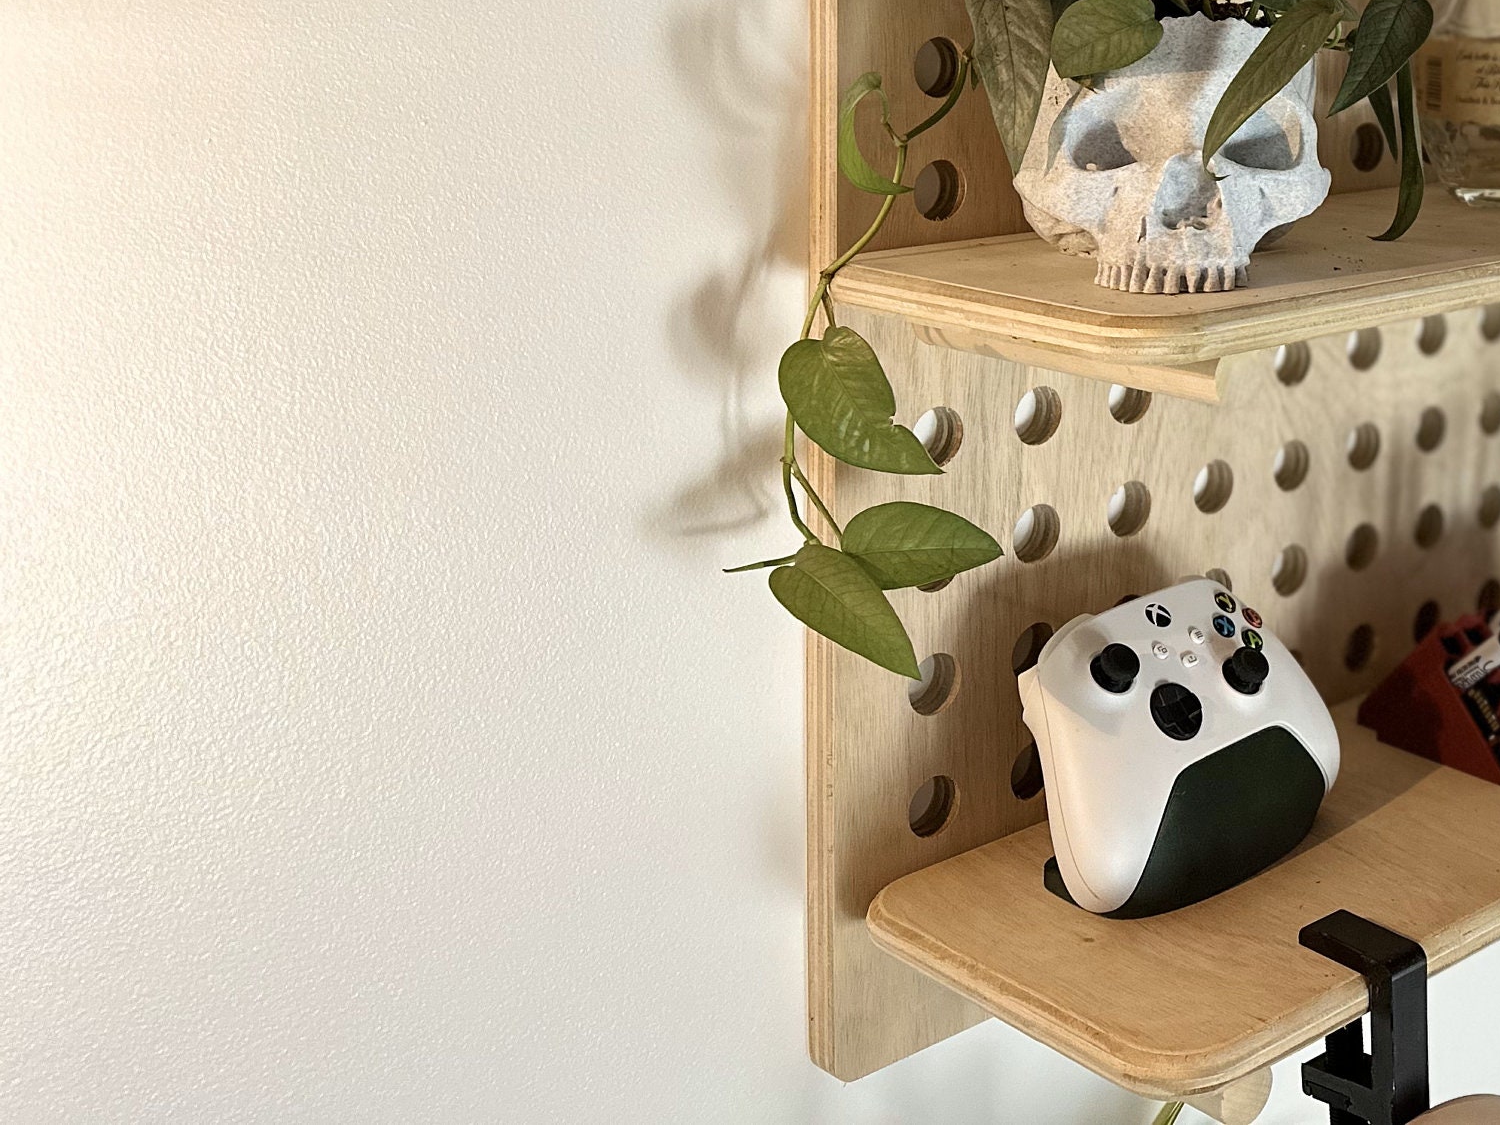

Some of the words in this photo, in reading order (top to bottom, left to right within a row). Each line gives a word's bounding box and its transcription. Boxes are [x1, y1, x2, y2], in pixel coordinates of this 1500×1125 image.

[1215, 594, 1234, 613] Y
[1214, 615, 1235, 636] X
[1248, 629, 1263, 649] A
